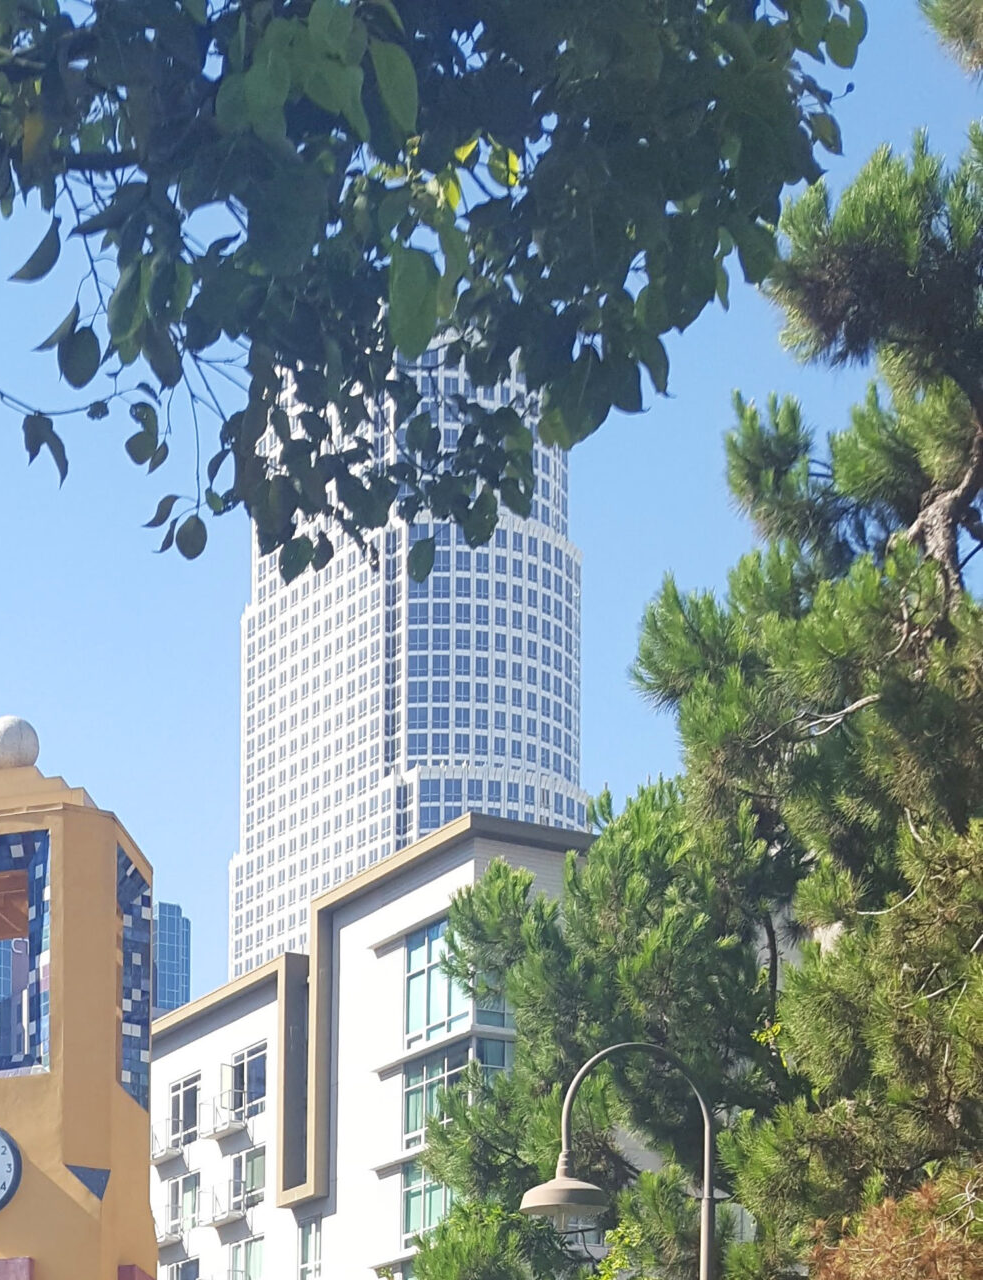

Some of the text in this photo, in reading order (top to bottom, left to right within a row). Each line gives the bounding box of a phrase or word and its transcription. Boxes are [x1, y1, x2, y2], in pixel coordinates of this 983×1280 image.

[1, 1146, 7, 1155] 2
[6, 1164, 12, 1173] 3
[0, 1182, 6, 1191] 4
